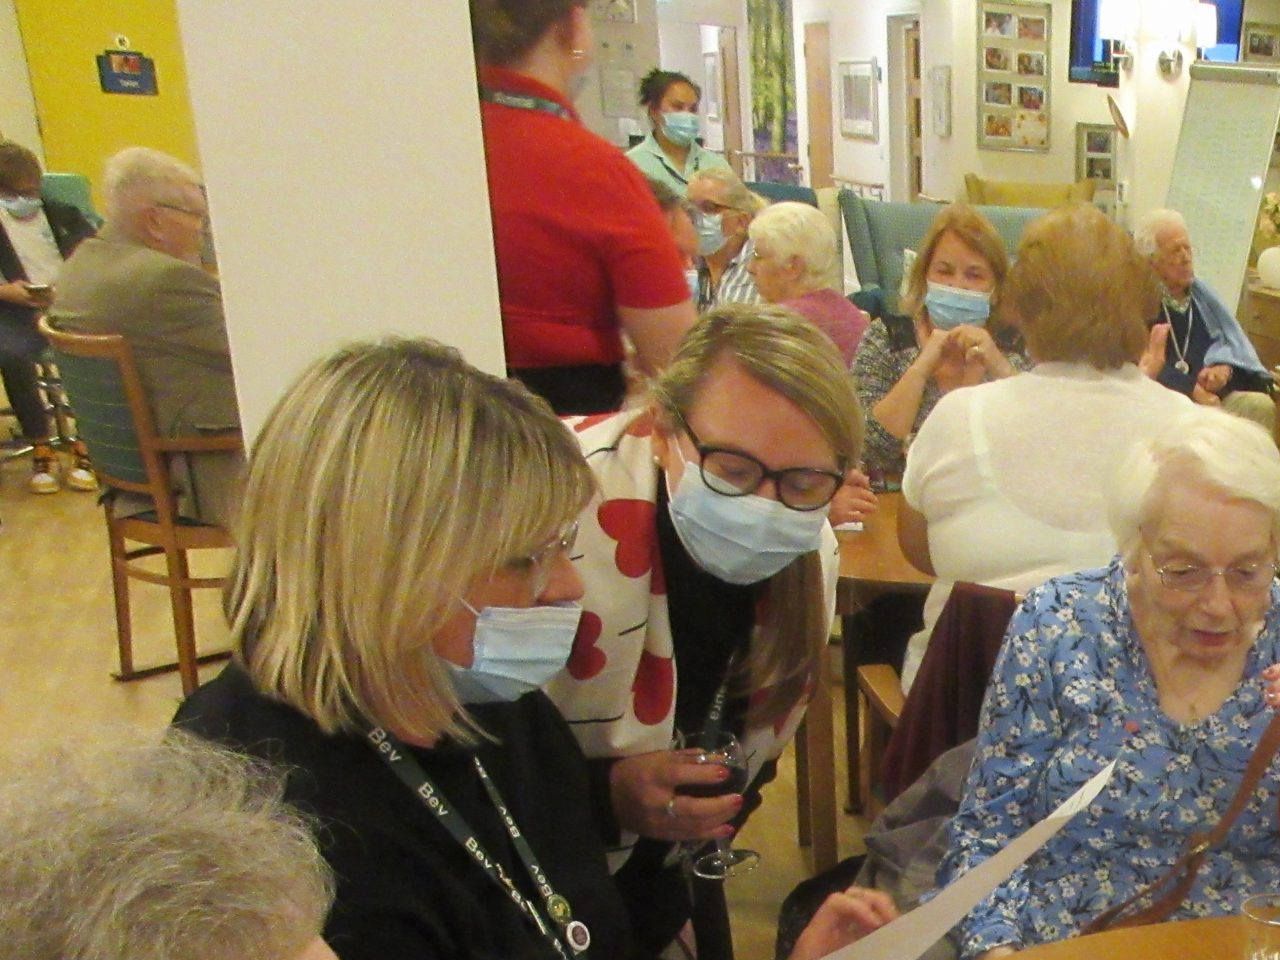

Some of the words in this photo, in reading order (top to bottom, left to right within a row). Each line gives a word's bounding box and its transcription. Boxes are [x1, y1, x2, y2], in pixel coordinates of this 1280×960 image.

[368, 727, 401, 762] Bev
[417, 782, 448, 817] Bev
[500, 806, 520, 838] Bev
[465, 837, 492, 868] Bev
[531, 865, 553, 896] Bev
